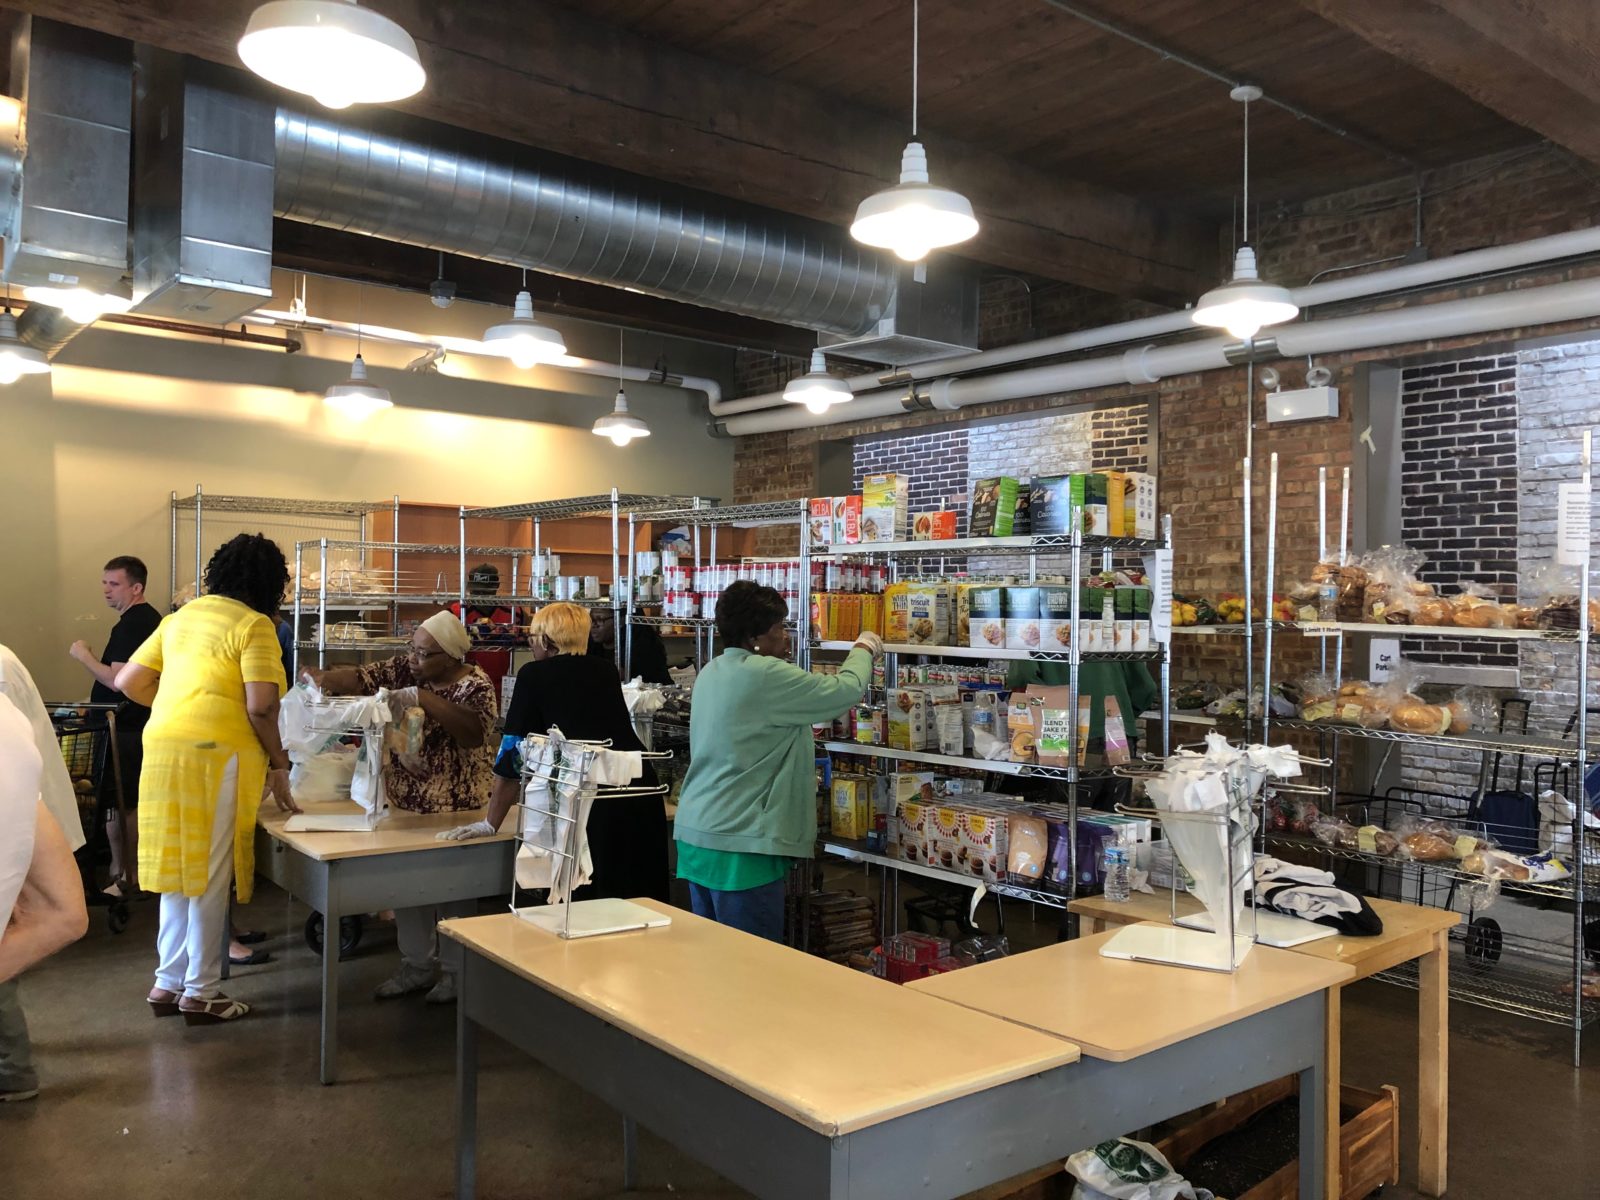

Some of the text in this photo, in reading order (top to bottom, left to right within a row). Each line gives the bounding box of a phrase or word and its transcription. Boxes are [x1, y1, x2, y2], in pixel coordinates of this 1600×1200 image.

[811, 503, 830, 516] MELBA
[847, 506, 856, 535] MELBA
[933, 514, 942, 539] MELB
[893, 602, 907, 610] THIN
[911, 598, 930, 606] triscuit
[1379, 654, 1391, 662] Cart
